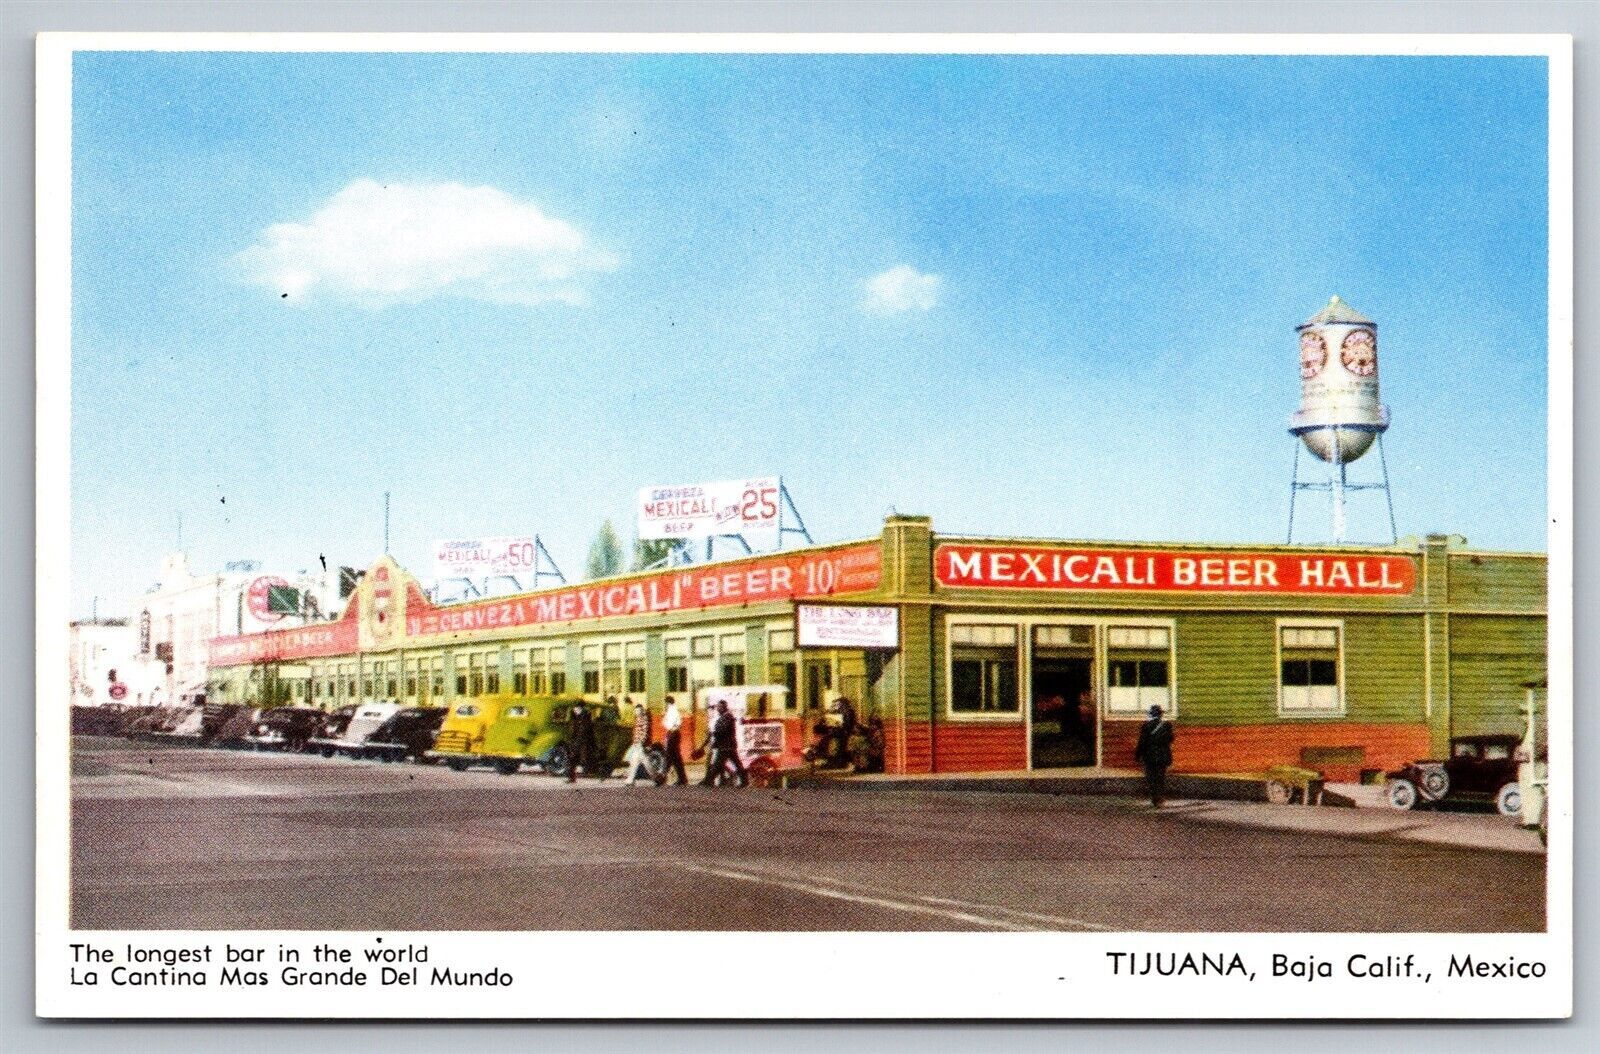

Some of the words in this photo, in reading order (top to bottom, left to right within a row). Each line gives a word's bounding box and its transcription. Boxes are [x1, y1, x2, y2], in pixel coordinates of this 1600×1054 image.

[644, 497, 717, 519] MEXICALI
[741, 487, 778, 521] 25
[509, 542, 535, 567] 50
[948, 550, 1157, 585] MEXICALI
[1173, 558, 1280, 587] BEER
[1299, 559, 1404, 589] HALL
[439, 602, 525, 632] CERVEZA
[700, 565, 794, 600] BEER
